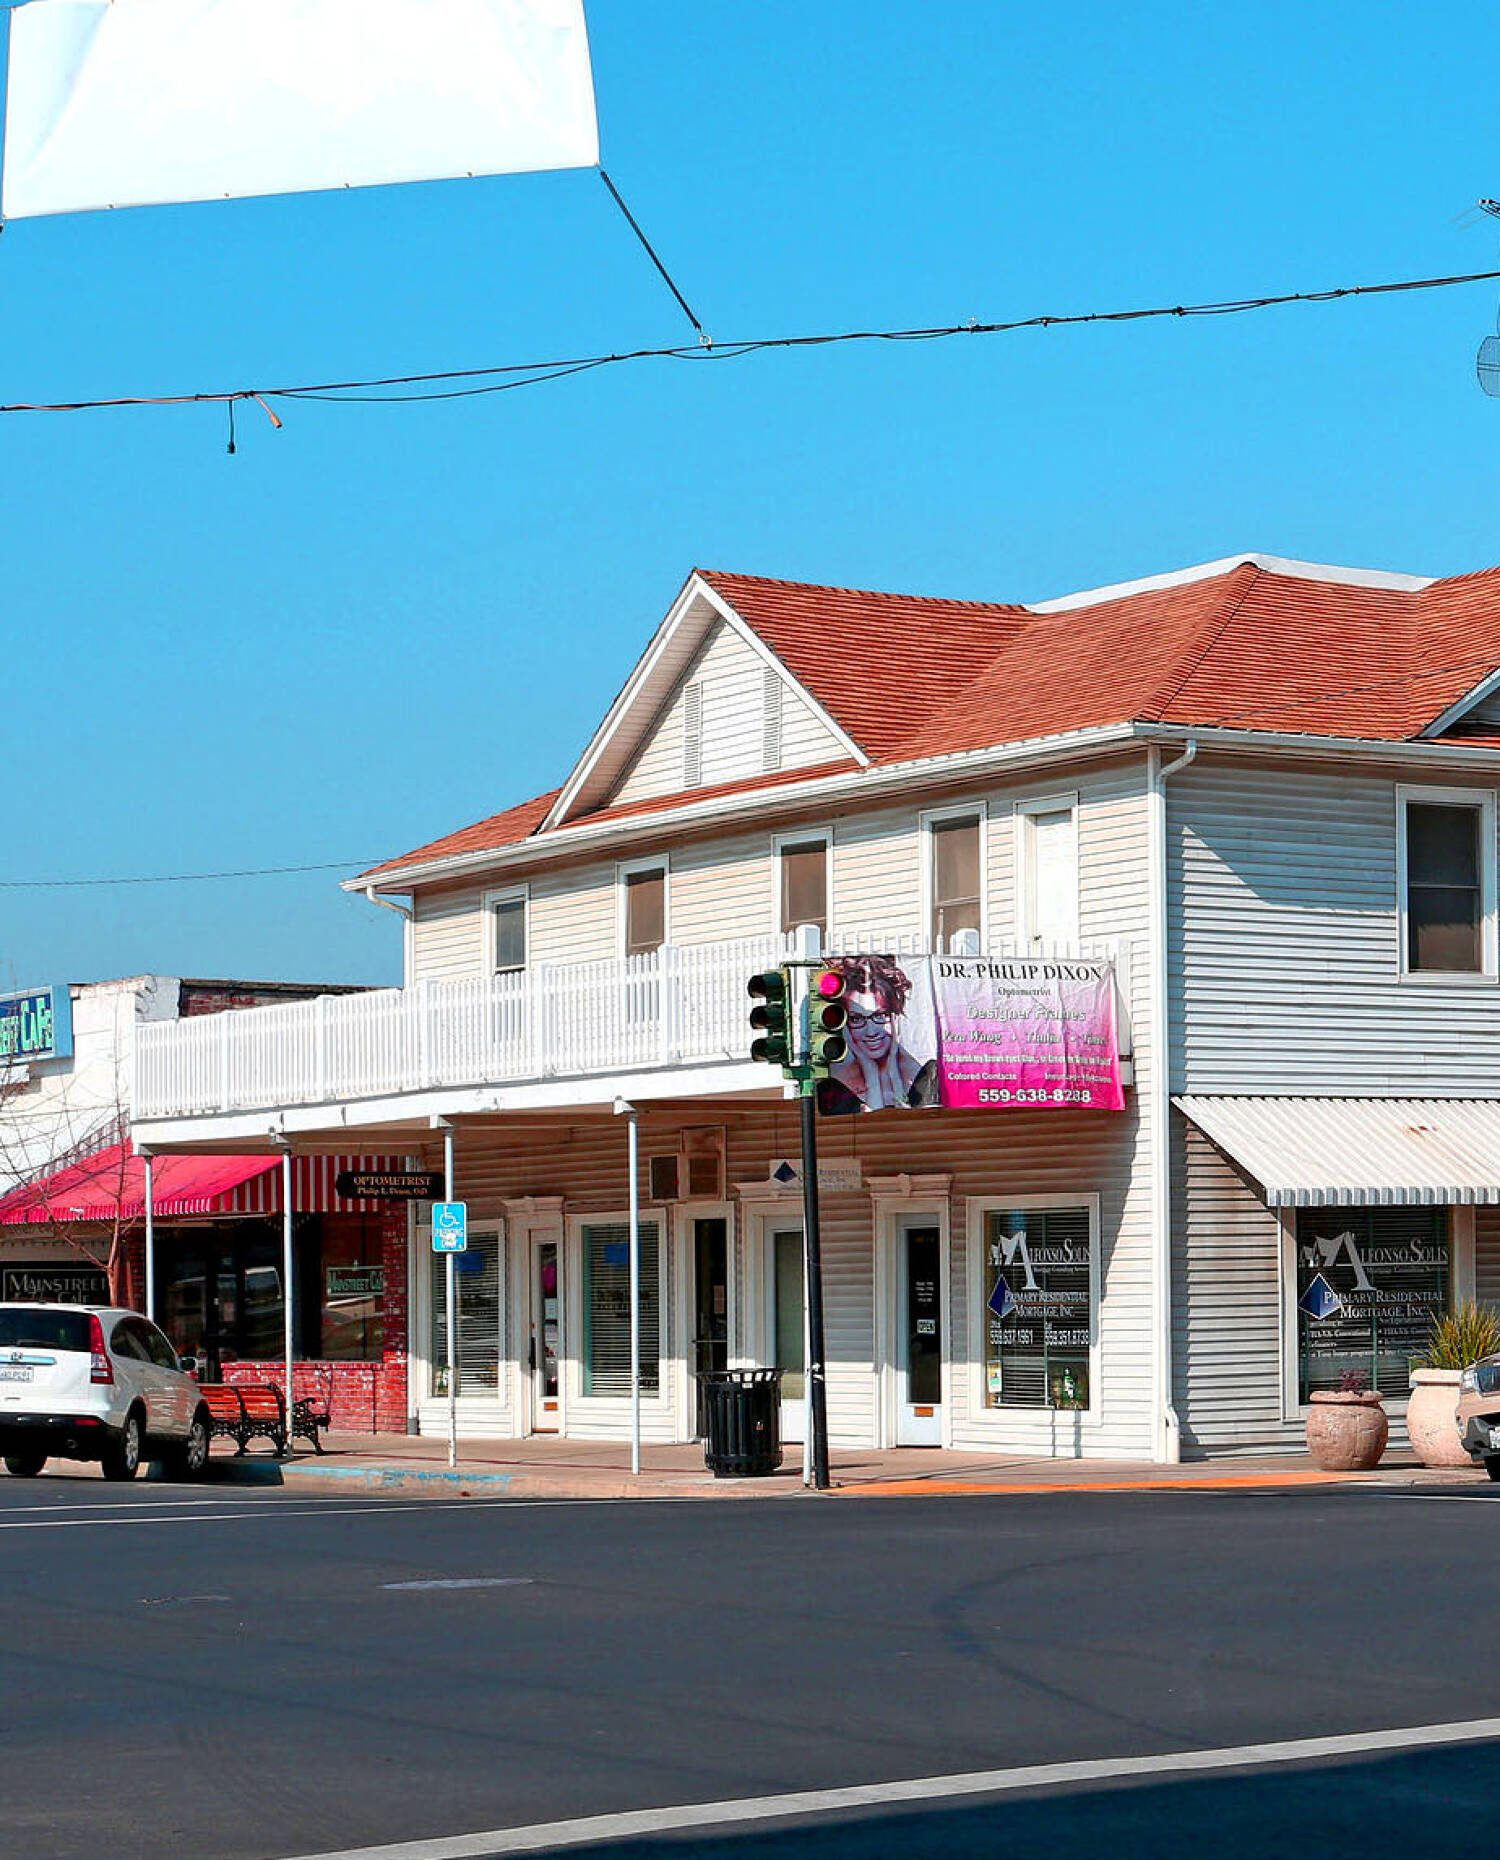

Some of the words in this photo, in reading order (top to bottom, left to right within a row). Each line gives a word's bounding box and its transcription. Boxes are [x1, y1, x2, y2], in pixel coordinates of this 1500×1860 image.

[940, 963, 972, 978] DR.
[977, 964, 1039, 980] PHILIP
[1043, 965, 1104, 981] DIXON
[10, 1273, 106, 1294] MAINSTREET
[1375, 1289, 1444, 1303] RESIDENTIAL
